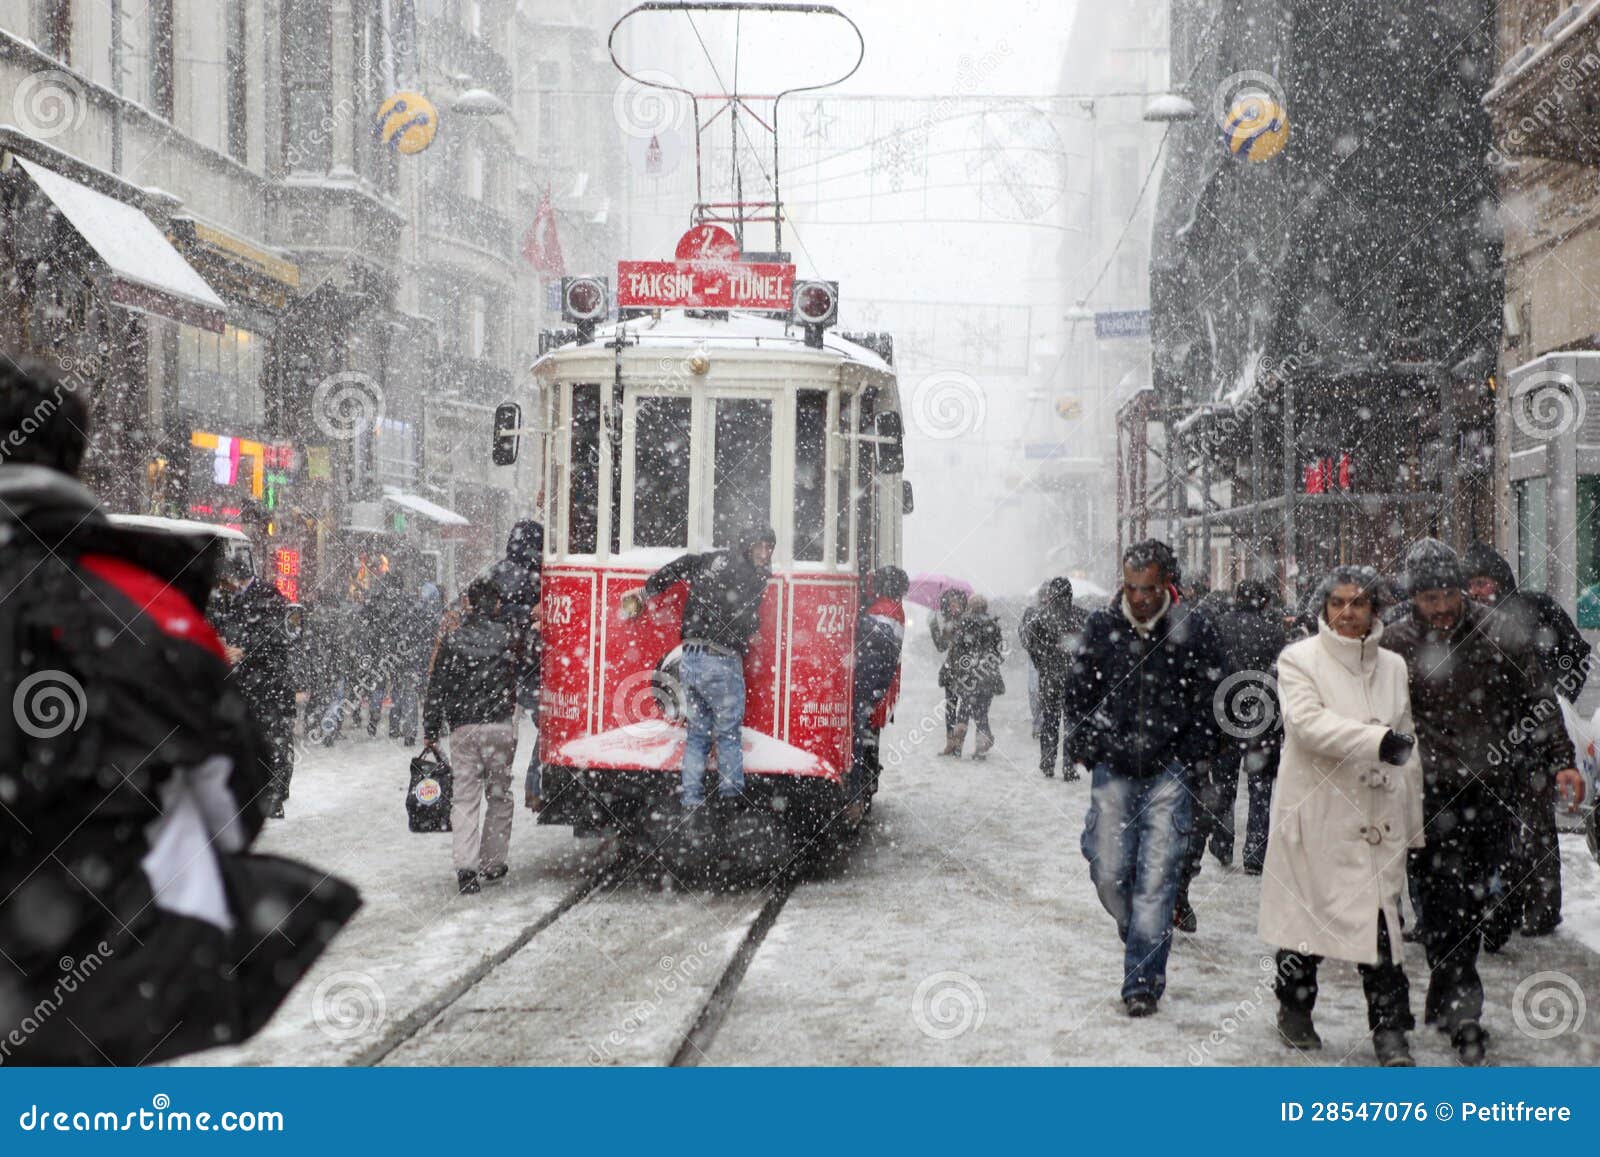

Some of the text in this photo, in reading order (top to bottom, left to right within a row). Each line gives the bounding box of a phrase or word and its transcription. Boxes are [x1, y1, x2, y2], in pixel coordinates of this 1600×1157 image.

[700, 227, 715, 254] 2
[545, 595, 572, 624] 223
[816, 604, 845, 632] 223
